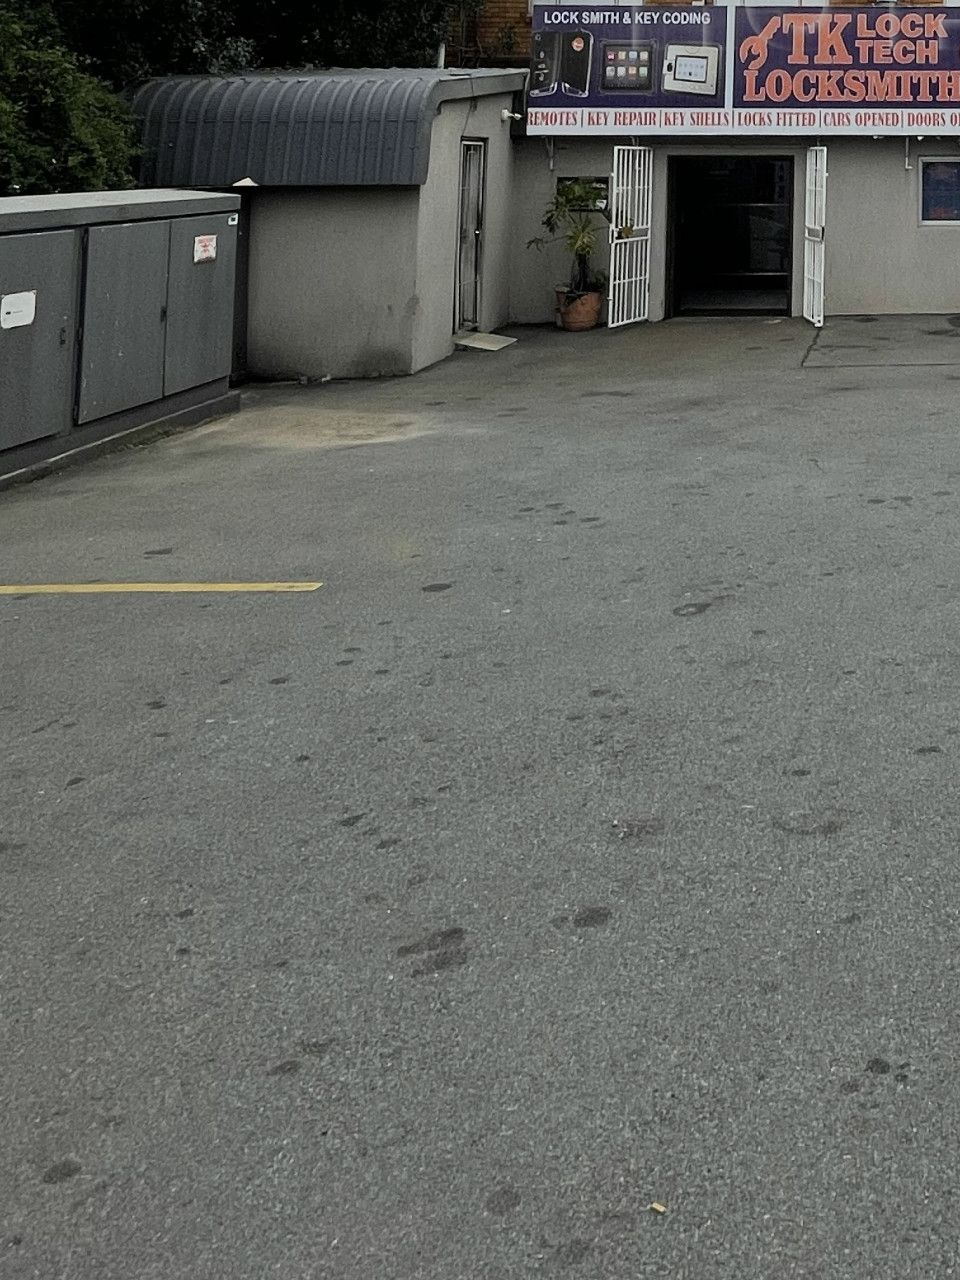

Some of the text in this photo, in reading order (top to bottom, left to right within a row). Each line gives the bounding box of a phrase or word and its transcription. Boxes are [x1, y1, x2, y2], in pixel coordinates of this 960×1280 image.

[544, 11, 711, 25] LOCK SMITH & KEY CODING
[856, 13, 949, 38] LOCK
[782, 13, 853, 65] TK
[855, 39, 939, 64] TECH
[527, 111, 578, 126] REMOTES
[587, 111, 657, 126] KEY REPAIR
[664, 111, 729, 126] KEY SHELLS
[737, 111, 816, 126] LOCKS FITTED
[823, 111, 899, 126] CARS OPENED
[907, 111, 946, 126] DOORS
